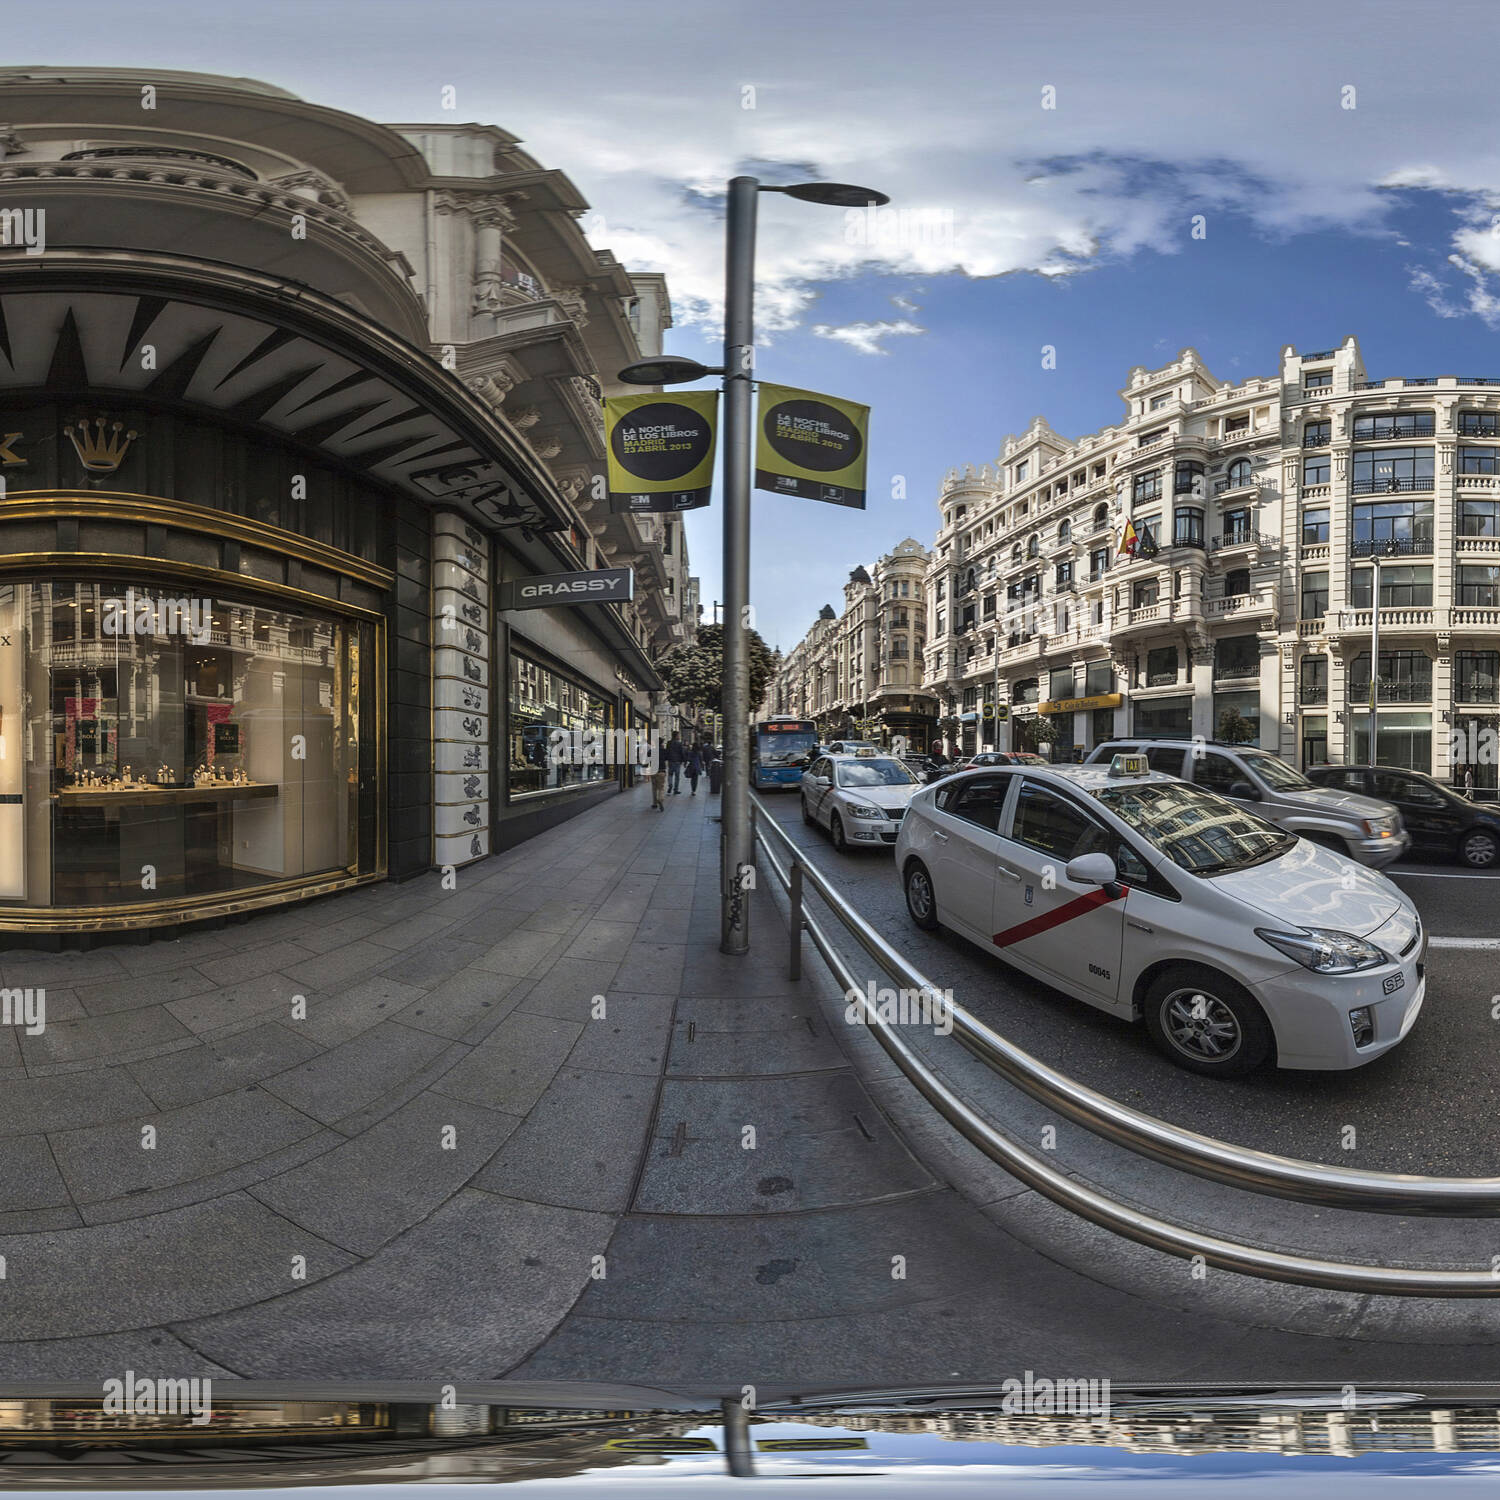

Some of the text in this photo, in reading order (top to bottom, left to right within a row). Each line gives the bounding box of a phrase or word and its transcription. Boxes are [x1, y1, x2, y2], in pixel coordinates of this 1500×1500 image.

[777, 413, 830, 428] LA NOCHE
[638, 424, 675, 433] NOCHE
[661, 430, 699, 439] LIBROS
[776, 425, 819, 438] MADRID
[794, 422, 813, 431] LOS
[815, 426, 850, 441] LIBROS
[624, 438, 665, 447] MADRID
[790, 432, 821, 444] ABRIL
[822, 440, 843, 450] 2013
[637, 444, 667, 453] ABRIL
[669, 443, 692, 451] 2013
[520, 577, 621, 598] GRASSY
[1126, 759, 1140, 771] TAXI
[1384, 973, 1403, 992] SP
